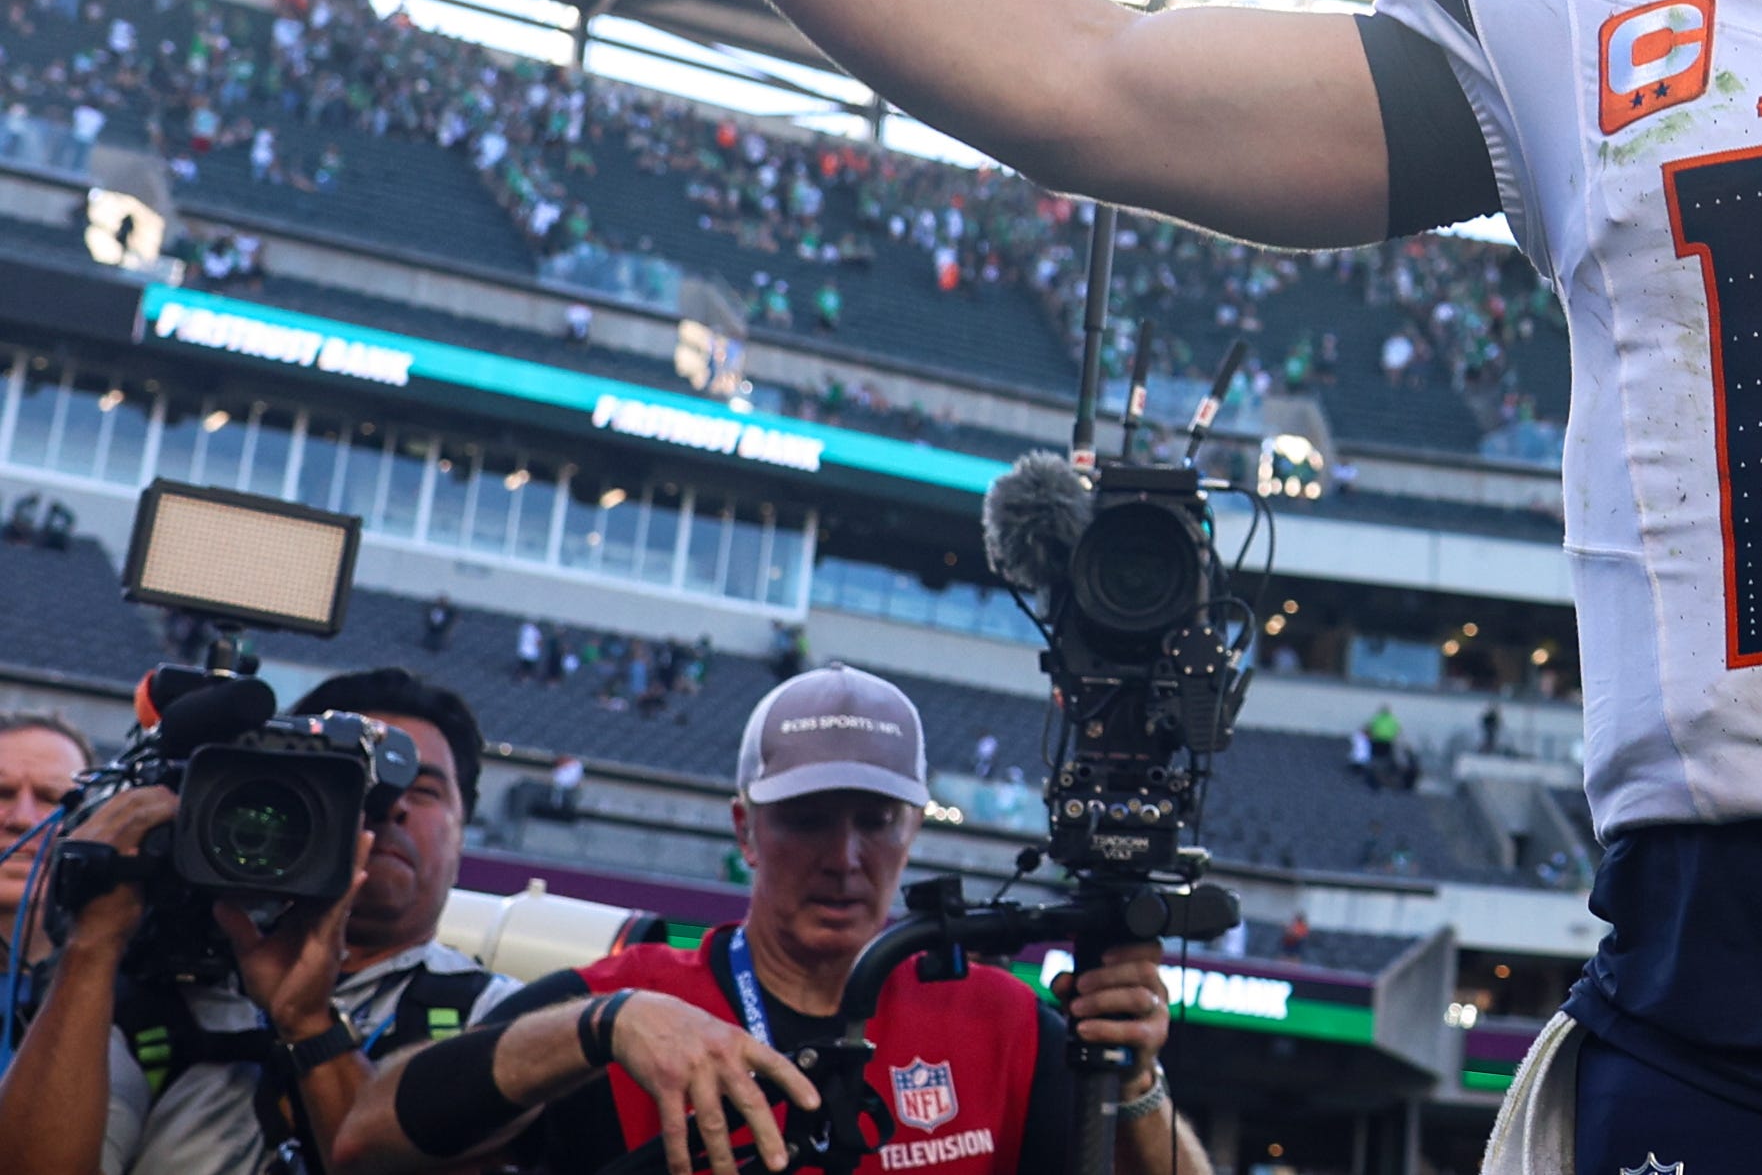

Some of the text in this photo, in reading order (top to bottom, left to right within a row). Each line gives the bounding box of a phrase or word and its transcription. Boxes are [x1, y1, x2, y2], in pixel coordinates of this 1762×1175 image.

[1608, 3, 1703, 95] C
[317, 336, 413, 387] BANK
[737, 424, 824, 472] BANK
[820, 714, 873, 731] SPORTS
[1199, 971, 1292, 1020] BANK
[903, 1088, 952, 1121] NFL
[879, 1128, 994, 1171] TELEVISION
